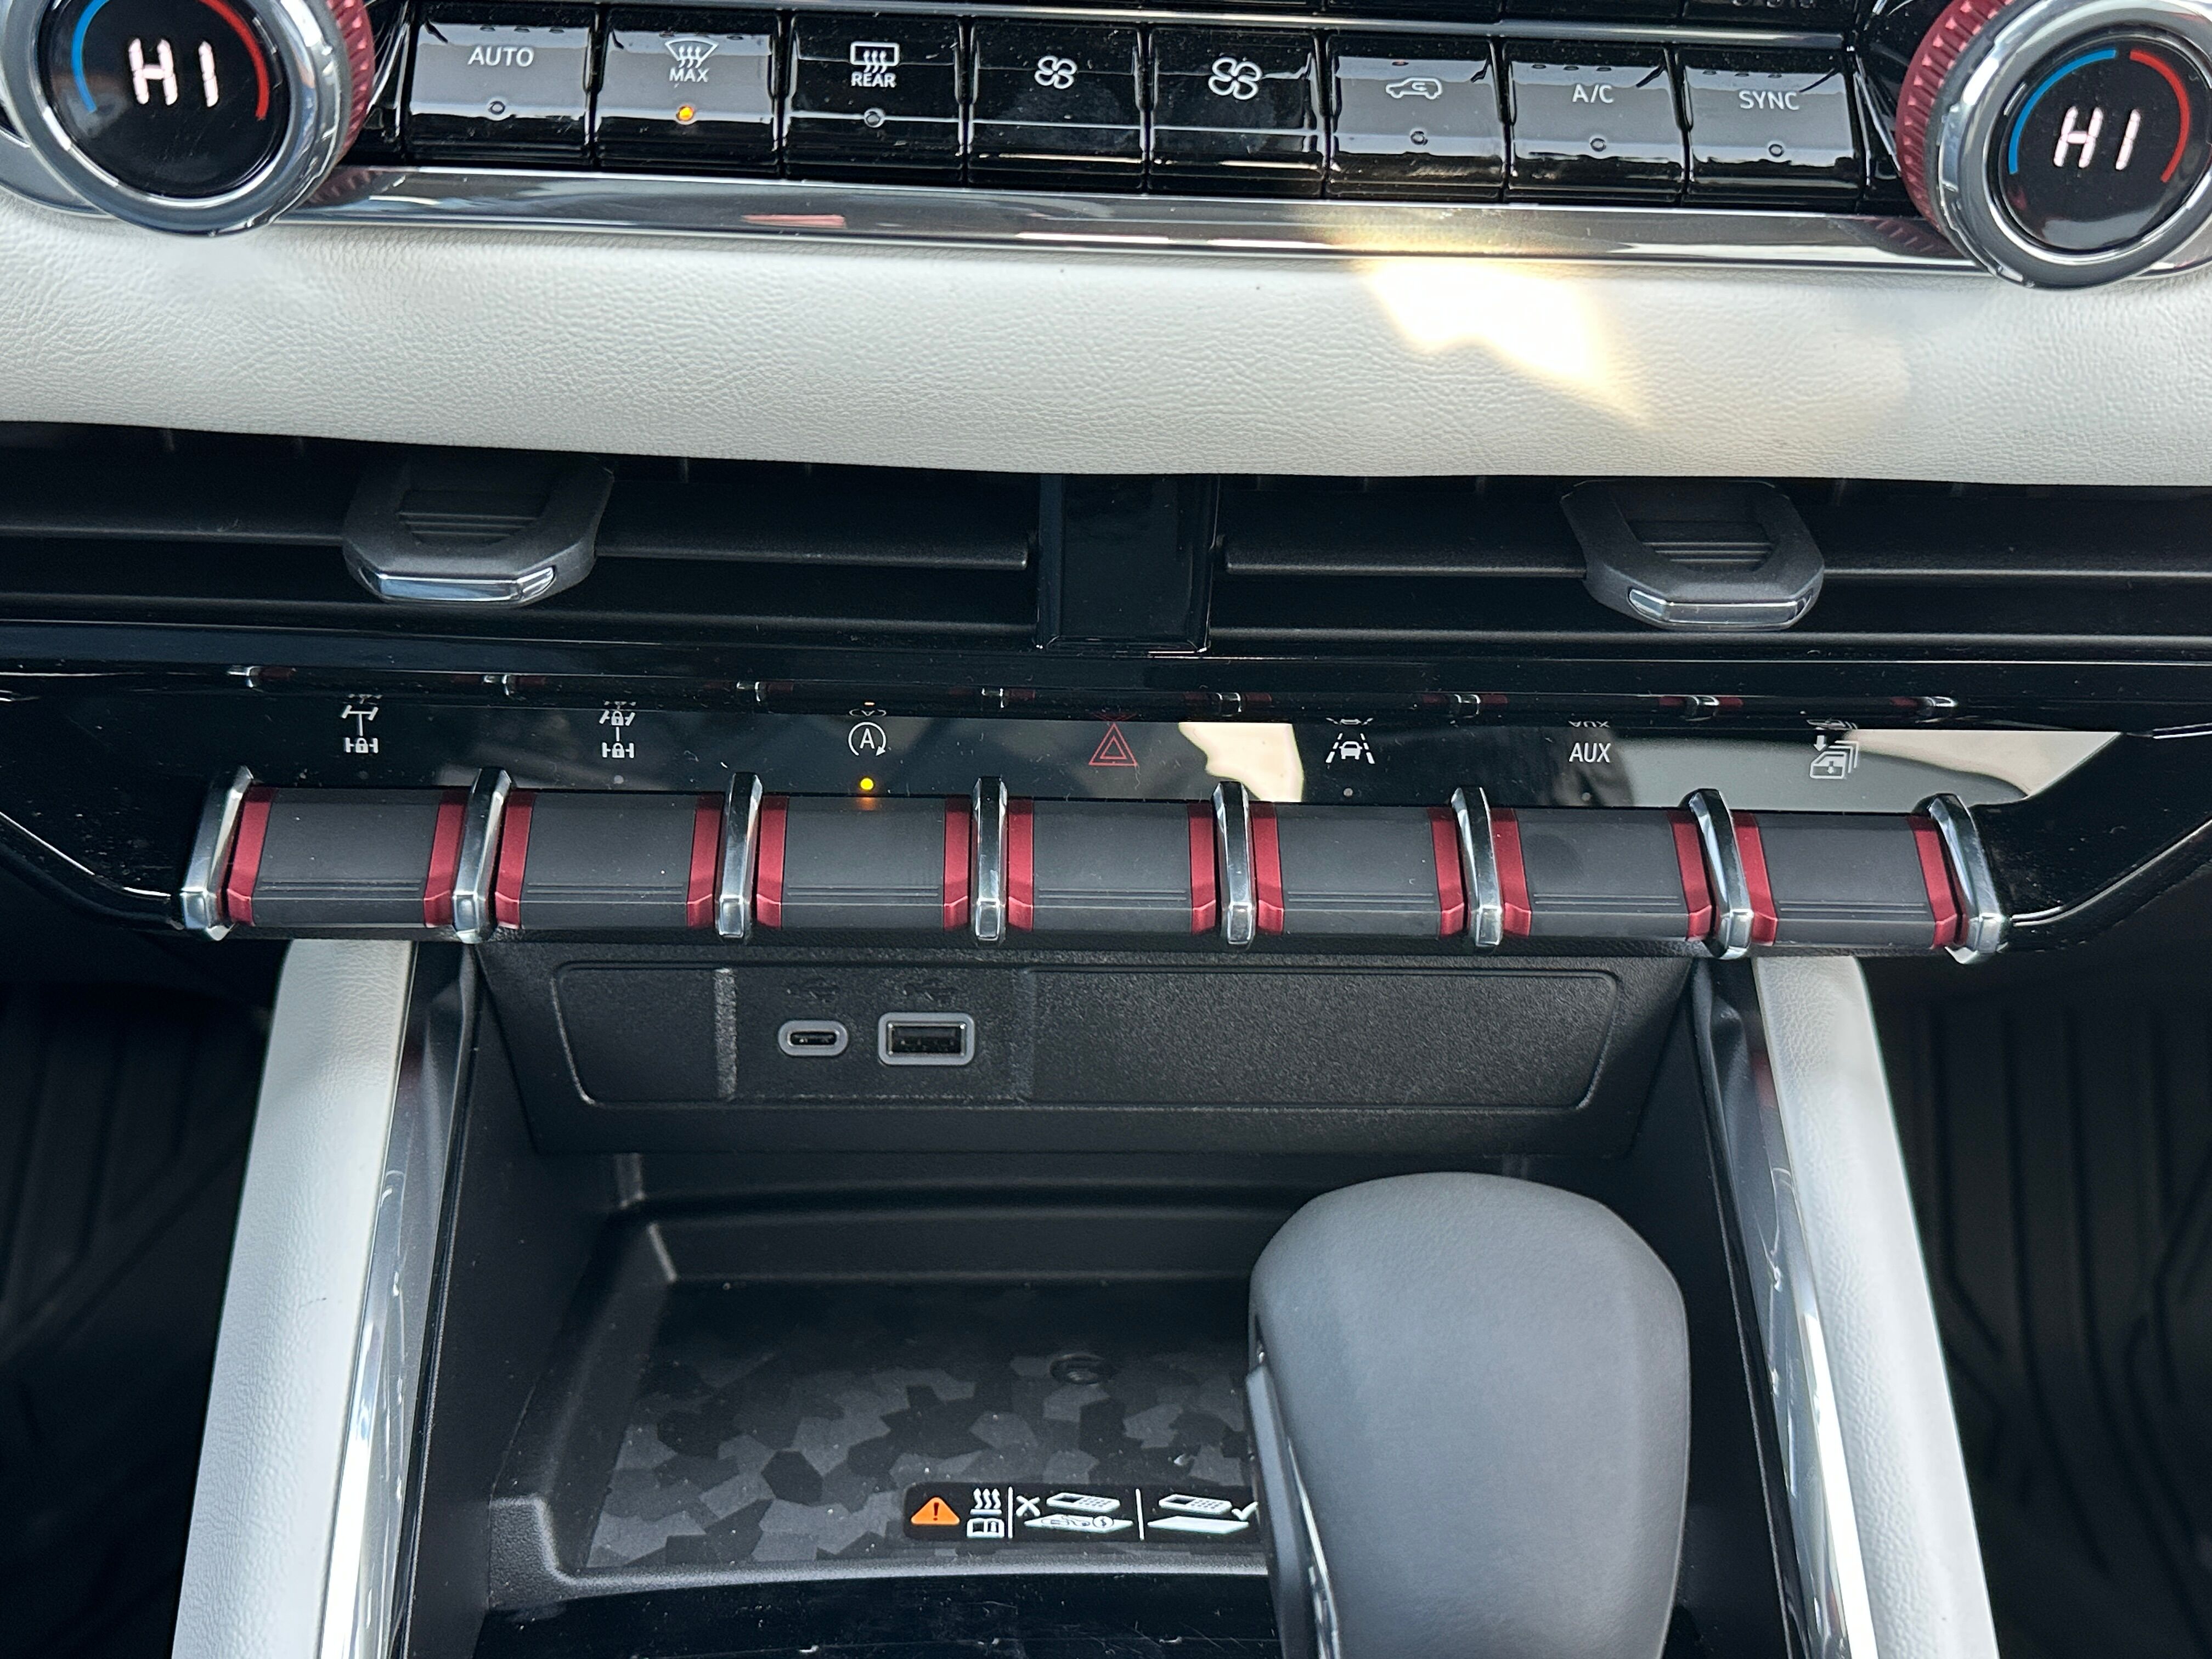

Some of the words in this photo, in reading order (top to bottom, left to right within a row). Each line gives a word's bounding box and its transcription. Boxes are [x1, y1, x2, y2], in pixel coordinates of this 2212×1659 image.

[467, 45, 534, 67] AUTO
[128, 37, 219, 107] HI
[669, 67, 710, 82] MAX
[851, 71, 896, 88] REAR
[1572, 83, 1614, 104] A/C
[1739, 89, 1799, 110] SYNC
[2052, 106, 2141, 171] HI
[860, 728, 875, 749] A
[1568, 742, 1611, 763] AUX
